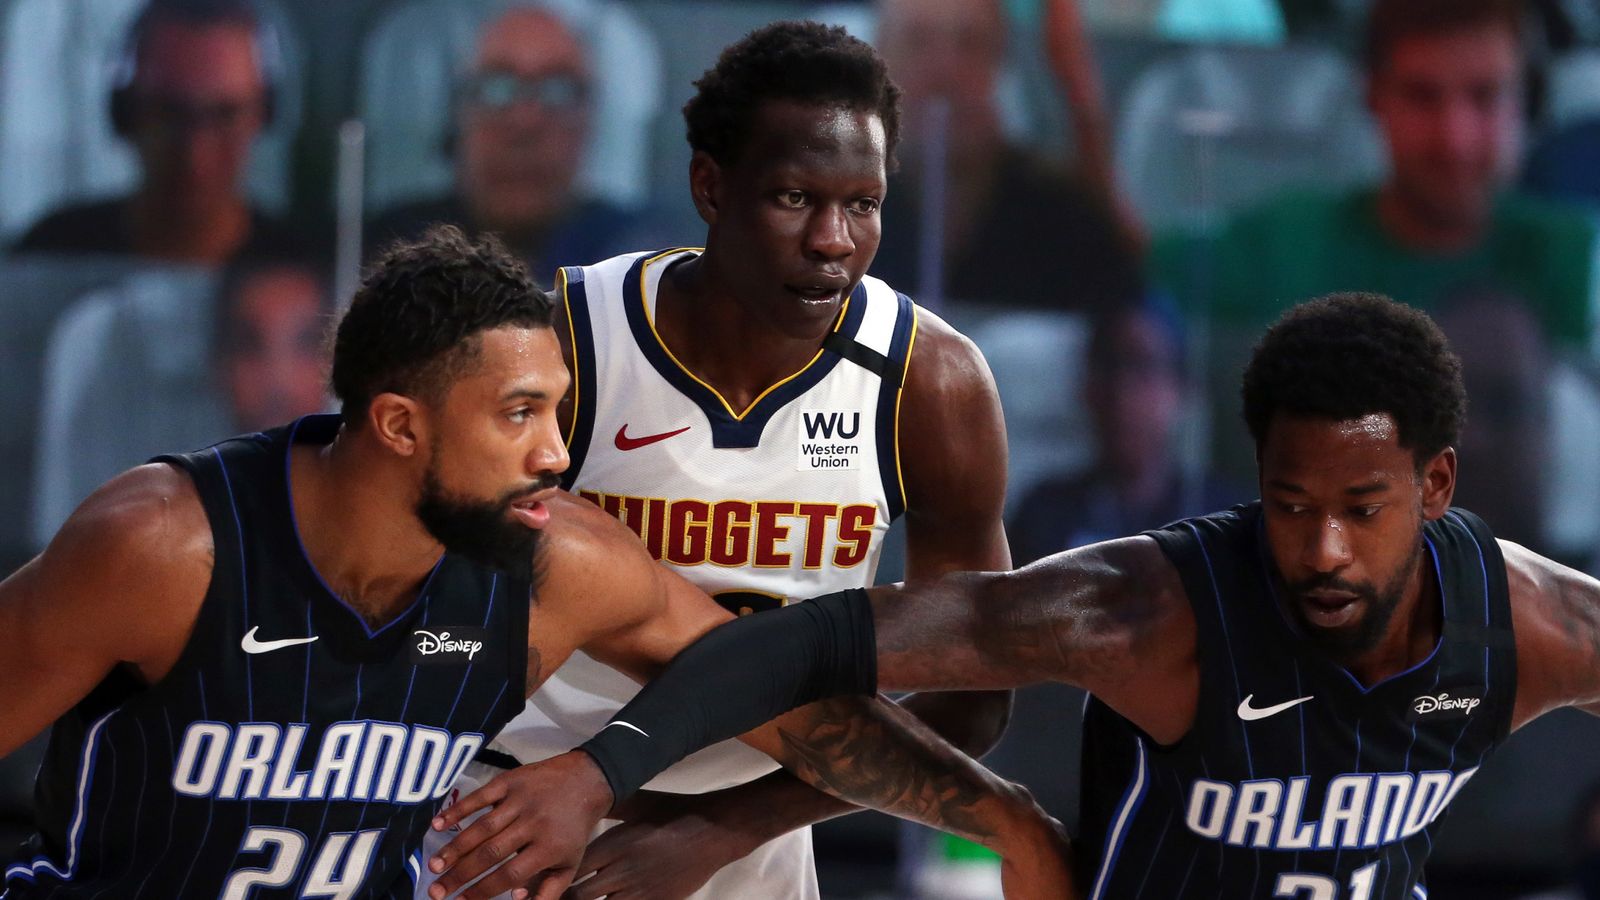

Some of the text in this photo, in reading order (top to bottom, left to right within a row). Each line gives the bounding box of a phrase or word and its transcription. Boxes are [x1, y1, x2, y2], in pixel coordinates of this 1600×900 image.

[802, 444, 858, 455] Western
[803, 412, 860, 440] WU
[811, 455, 849, 468] Union
[578, 489, 877, 569] UGGETS
[171, 719, 485, 806] ORLANDO
[217, 825, 390, 900] 24
